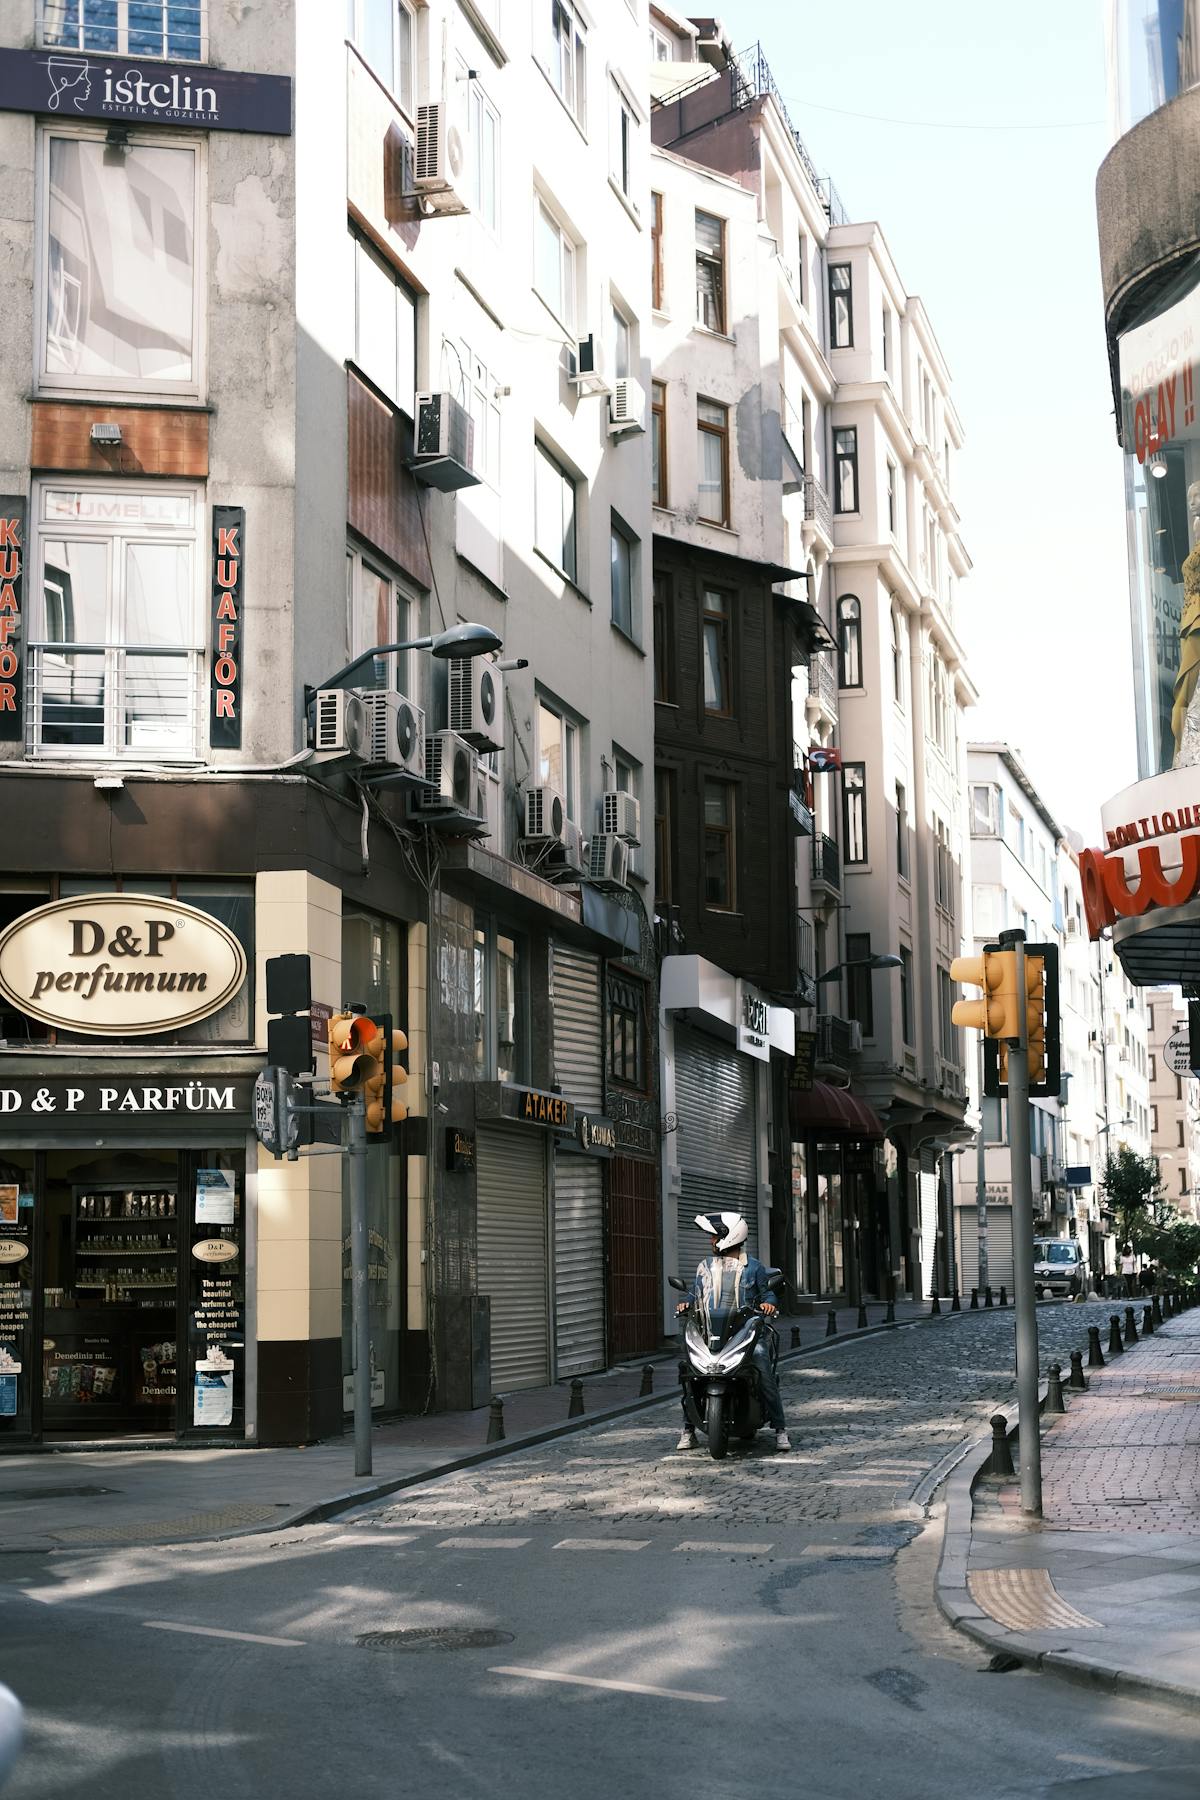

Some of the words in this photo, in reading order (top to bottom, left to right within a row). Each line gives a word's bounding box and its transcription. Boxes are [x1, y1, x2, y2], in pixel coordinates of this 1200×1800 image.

[103, 68, 219, 113] istclin
[1135, 372, 1177, 465] OLAY
[214, 527, 240, 718] KUAFÖR
[29, 963, 207, 999] perfumum
[31, 1088, 56, 1112] &
[65, 1089, 85, 1111] P
[99, 1081, 236, 1111] PARFÜM
[525, 1093, 568, 1125] ATAKER
[207, 1332, 227, 1340] prices
[208, 1321, 237, 1329] cheapest
